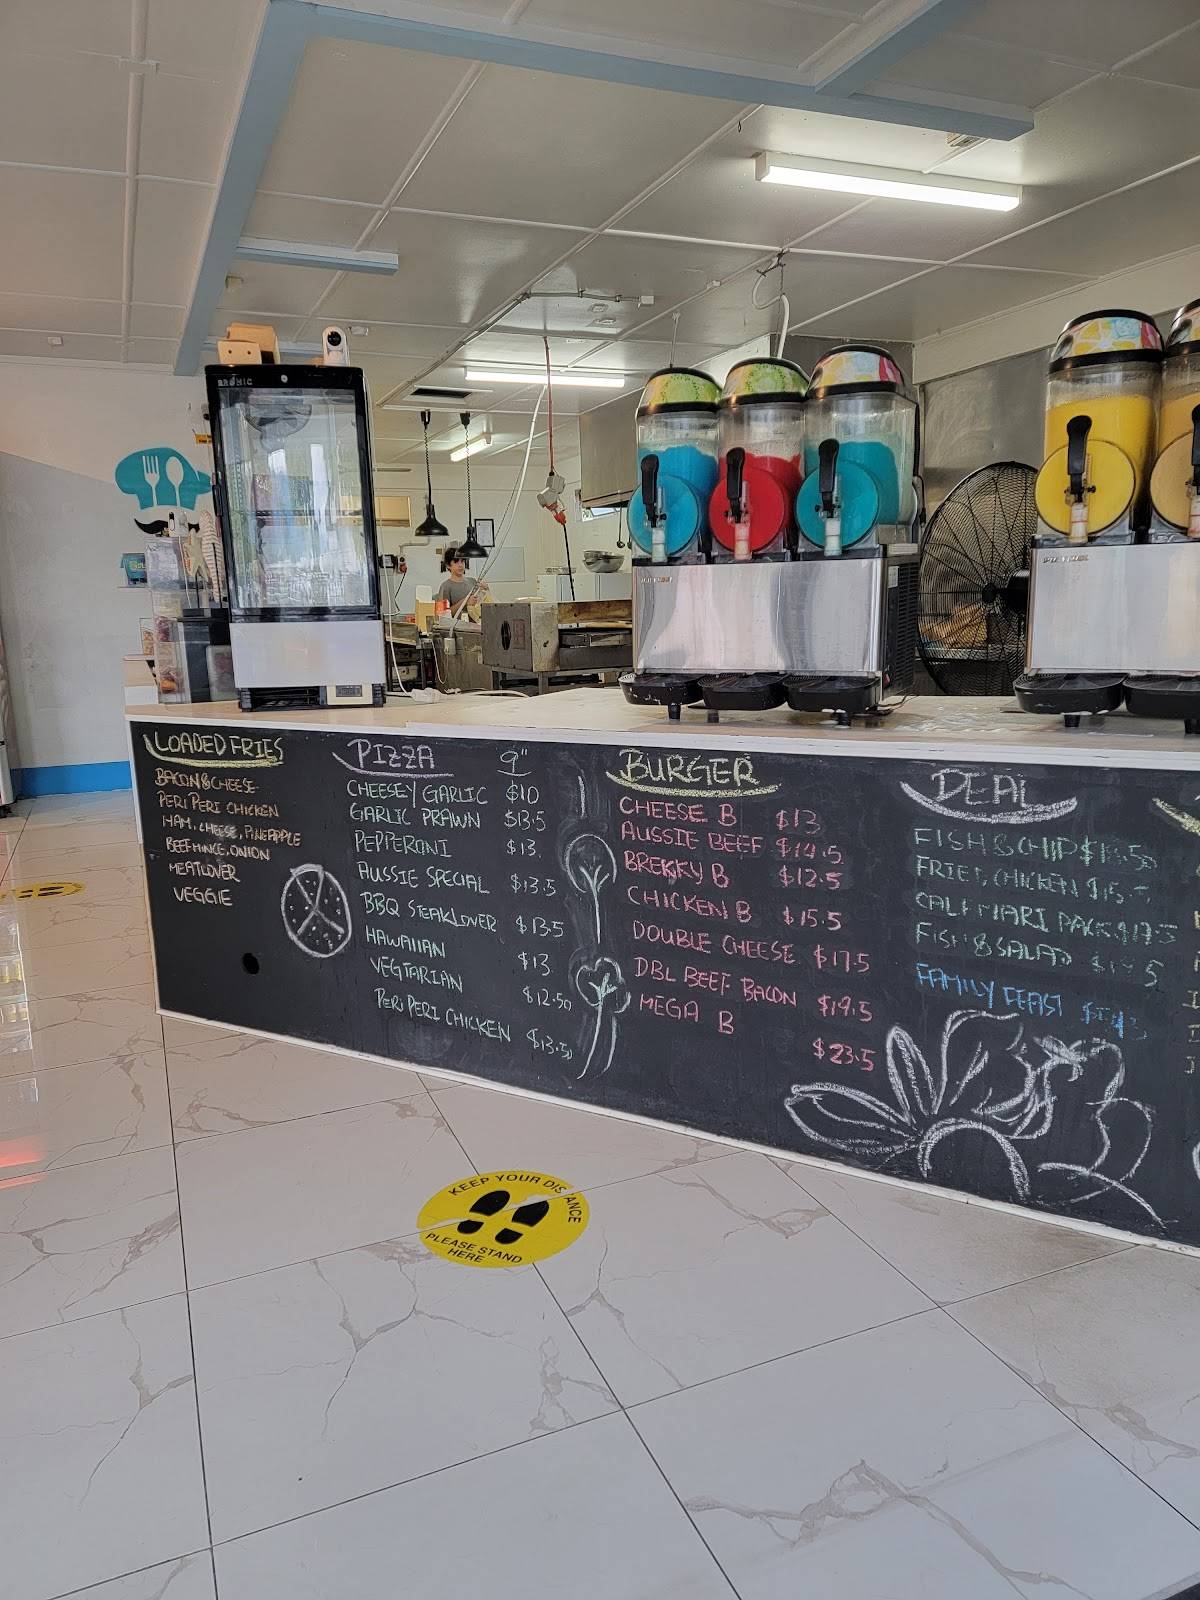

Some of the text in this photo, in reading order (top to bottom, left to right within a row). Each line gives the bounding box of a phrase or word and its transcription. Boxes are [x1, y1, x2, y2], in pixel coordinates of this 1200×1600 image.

[154, 731, 284, 761] LOADED FRIES
[347, 738, 435, 769] PIZZA
[619, 748, 760, 786] BURGER
[156, 790, 280, 818] PERI PERI CHICKEN
[422, 785, 488, 805] GARLIC
[505, 780, 539, 804] $10
[931, 768, 1034, 809] DEAL
[350, 802, 546, 832] GARLIC PRAWN $13.5
[620, 796, 822, 835] CHEESE B $13
[354, 830, 452, 857] PEPPERONI
[621, 820, 843, 865] AUSSIE BEEF $14.5
[914, 828, 987, 856] FISH
[169, 861, 240, 882] MEATLOVER
[357, 861, 556, 896] AUSSIE SPECIAL $13.5
[623, 850, 843, 890] BREKKY B $12.5
[993, 868, 1079, 899] CHICKEN
[173, 886, 233, 906] VEGGIE
[627, 885, 843, 930] CHICKEN B $15.5
[360, 892, 400, 917] BBQ
[515, 916, 564, 937] $13.5
[365, 925, 551, 976] HAWAIIAN $13
[633, 920, 871, 973] DOUBLE CHEESE $17.5
[522, 986, 572, 1011] $12.50
[634, 956, 873, 1022] DBL BEEF BACON $19.5
[916, 962, 1063, 1017] FAMILY FEAST
[374, 988, 404, 1013] PERI
[408, 995, 440, 1020] PERI
[446, 1009, 511, 1042] CHICKEN
[639, 993, 877, 1072] MEGA B $23.5
[448, 1174, 582, 1224] KEEP YOUR DISANCE
[426, 1232, 523, 1264] PLEASE STAND
[448, 1247, 486, 1263] HERE
